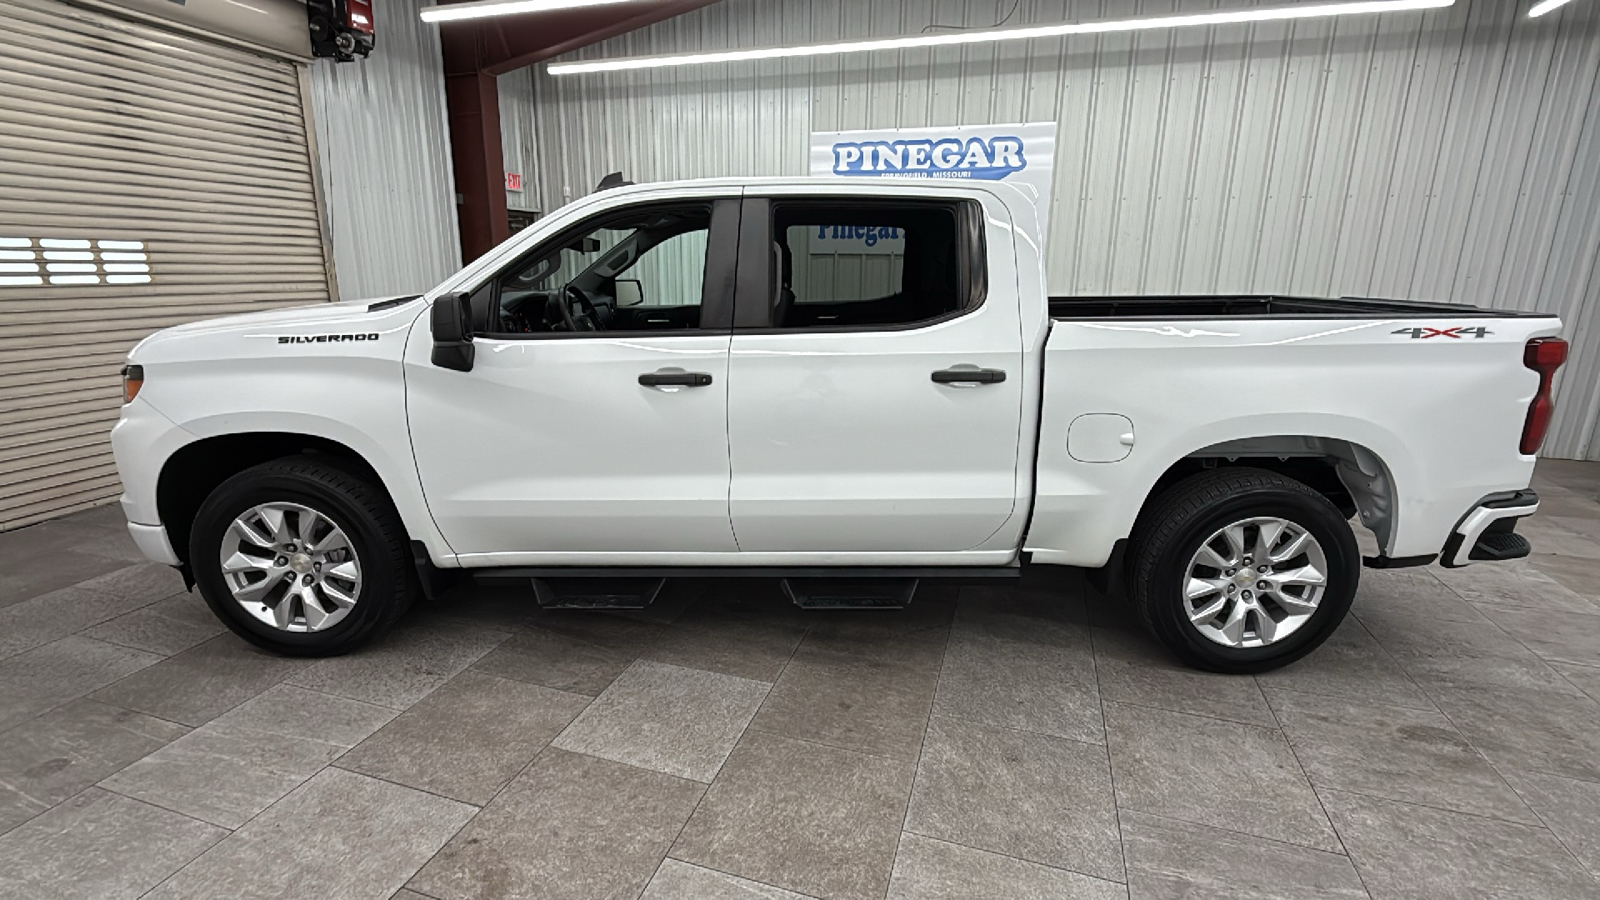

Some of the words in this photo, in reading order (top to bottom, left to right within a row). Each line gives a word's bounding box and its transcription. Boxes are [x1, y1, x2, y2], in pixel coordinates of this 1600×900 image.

[835, 140, 1023, 171] PINEGAR
[507, 172, 521, 189] EXIT
[932, 171, 971, 179] MISSOURI
[278, 333, 379, 344] SILVERADO
